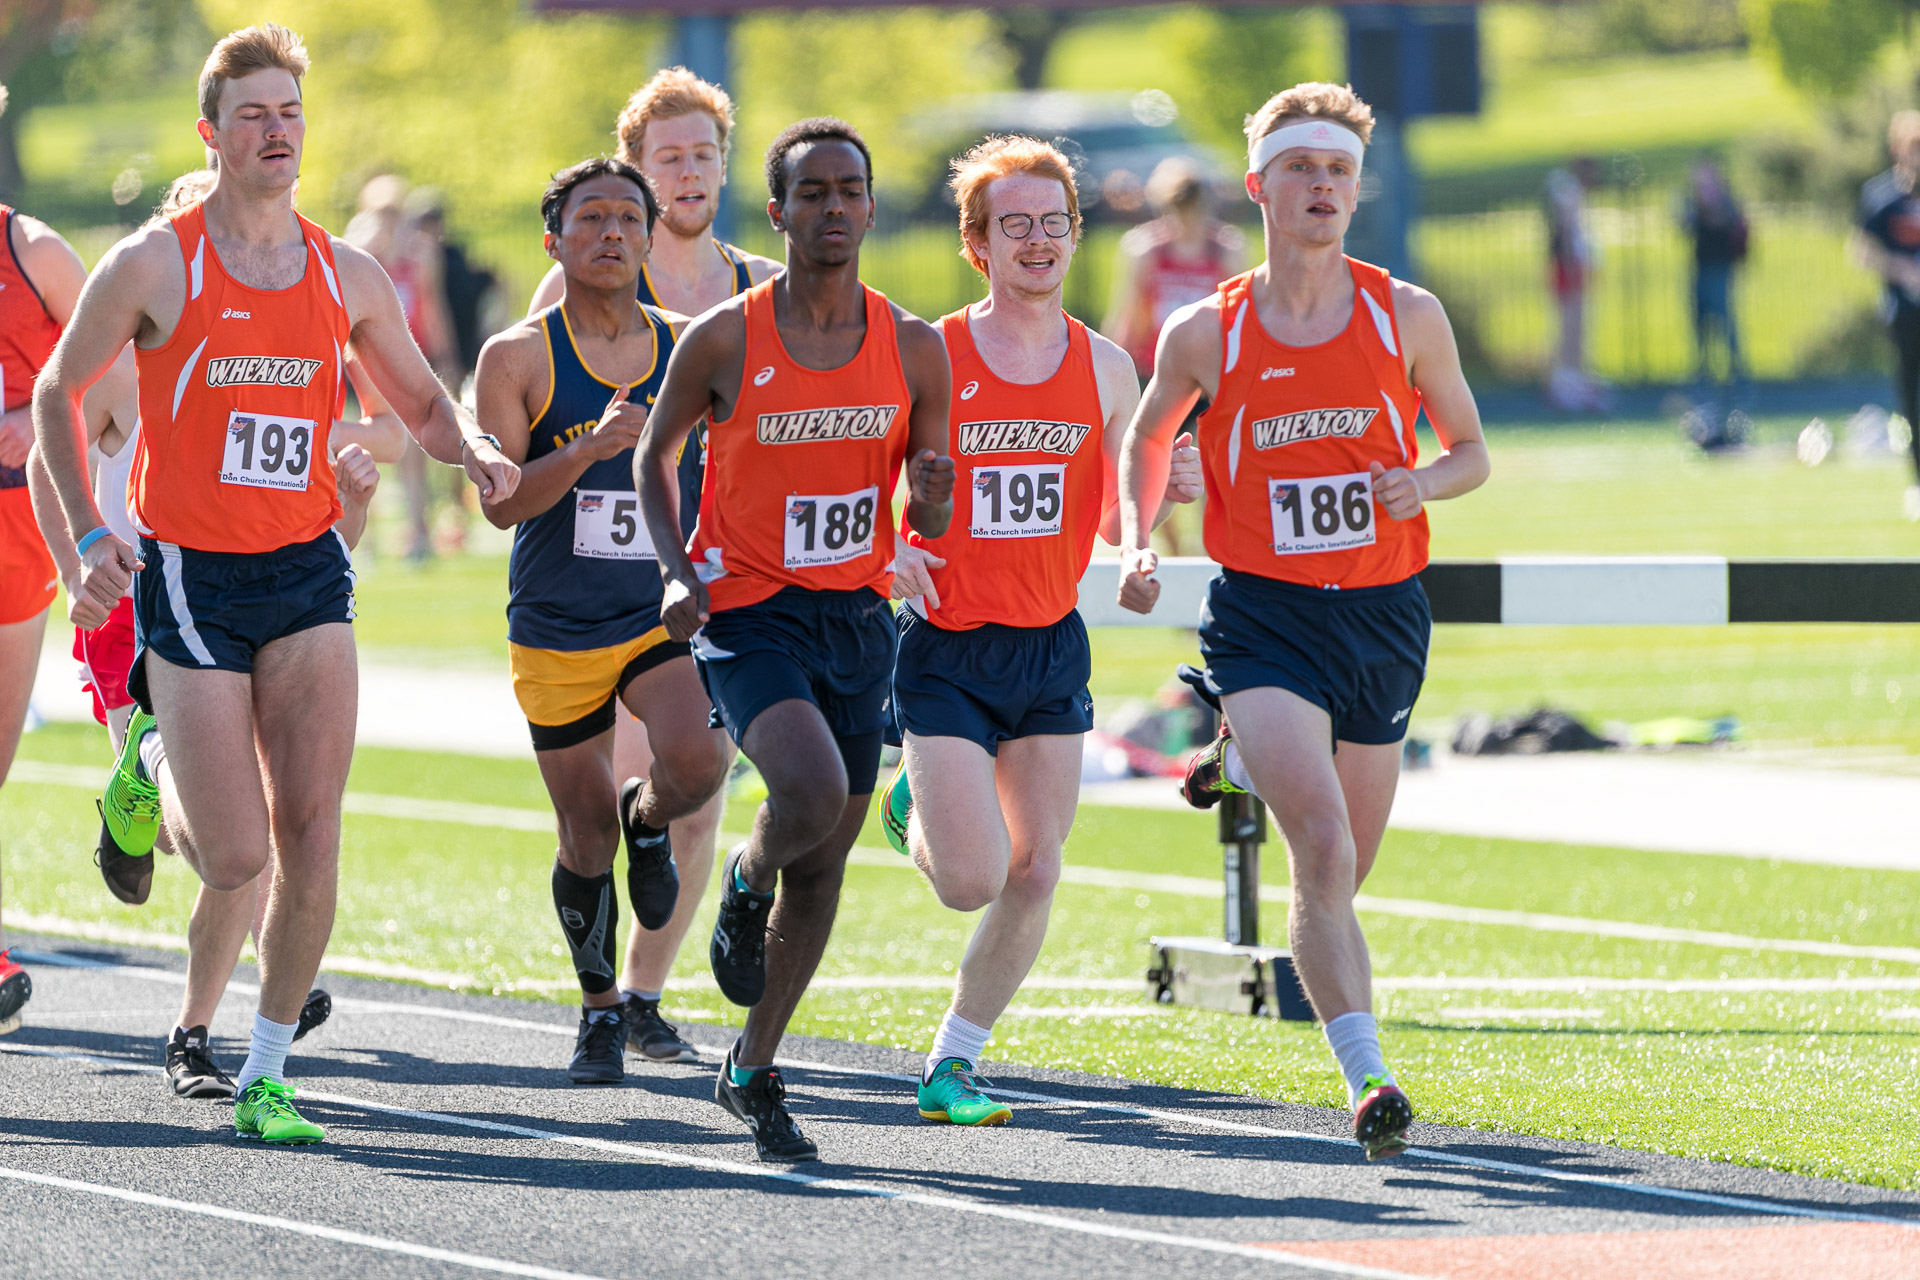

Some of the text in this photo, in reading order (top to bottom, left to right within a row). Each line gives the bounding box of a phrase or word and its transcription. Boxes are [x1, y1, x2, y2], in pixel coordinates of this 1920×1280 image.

[230, 310, 251, 319] asics
[206, 356, 323, 387] WHEATON
[756, 405, 899, 445] WHEATON
[958, 419, 1091, 455] WHEATON
[1252, 407, 1380, 450] WHEATON
[235, 420, 309, 476] 193
[222, 474, 307, 489] Don Church Invitational
[982, 473, 1061, 523] 195
[610, 500, 636, 546] 5
[796, 497, 873, 552] 188
[1282, 481, 1371, 538] 186
[1021, 526, 1060, 535] Invitational
[1295, 543, 1326, 551] Church
[1328, 536, 1374, 548] Invitational
[575, 547, 589, 555] Don
[591, 549, 619, 557] Church
[803, 556, 832, 564] Church
[834, 546, 871, 561] Invitational
